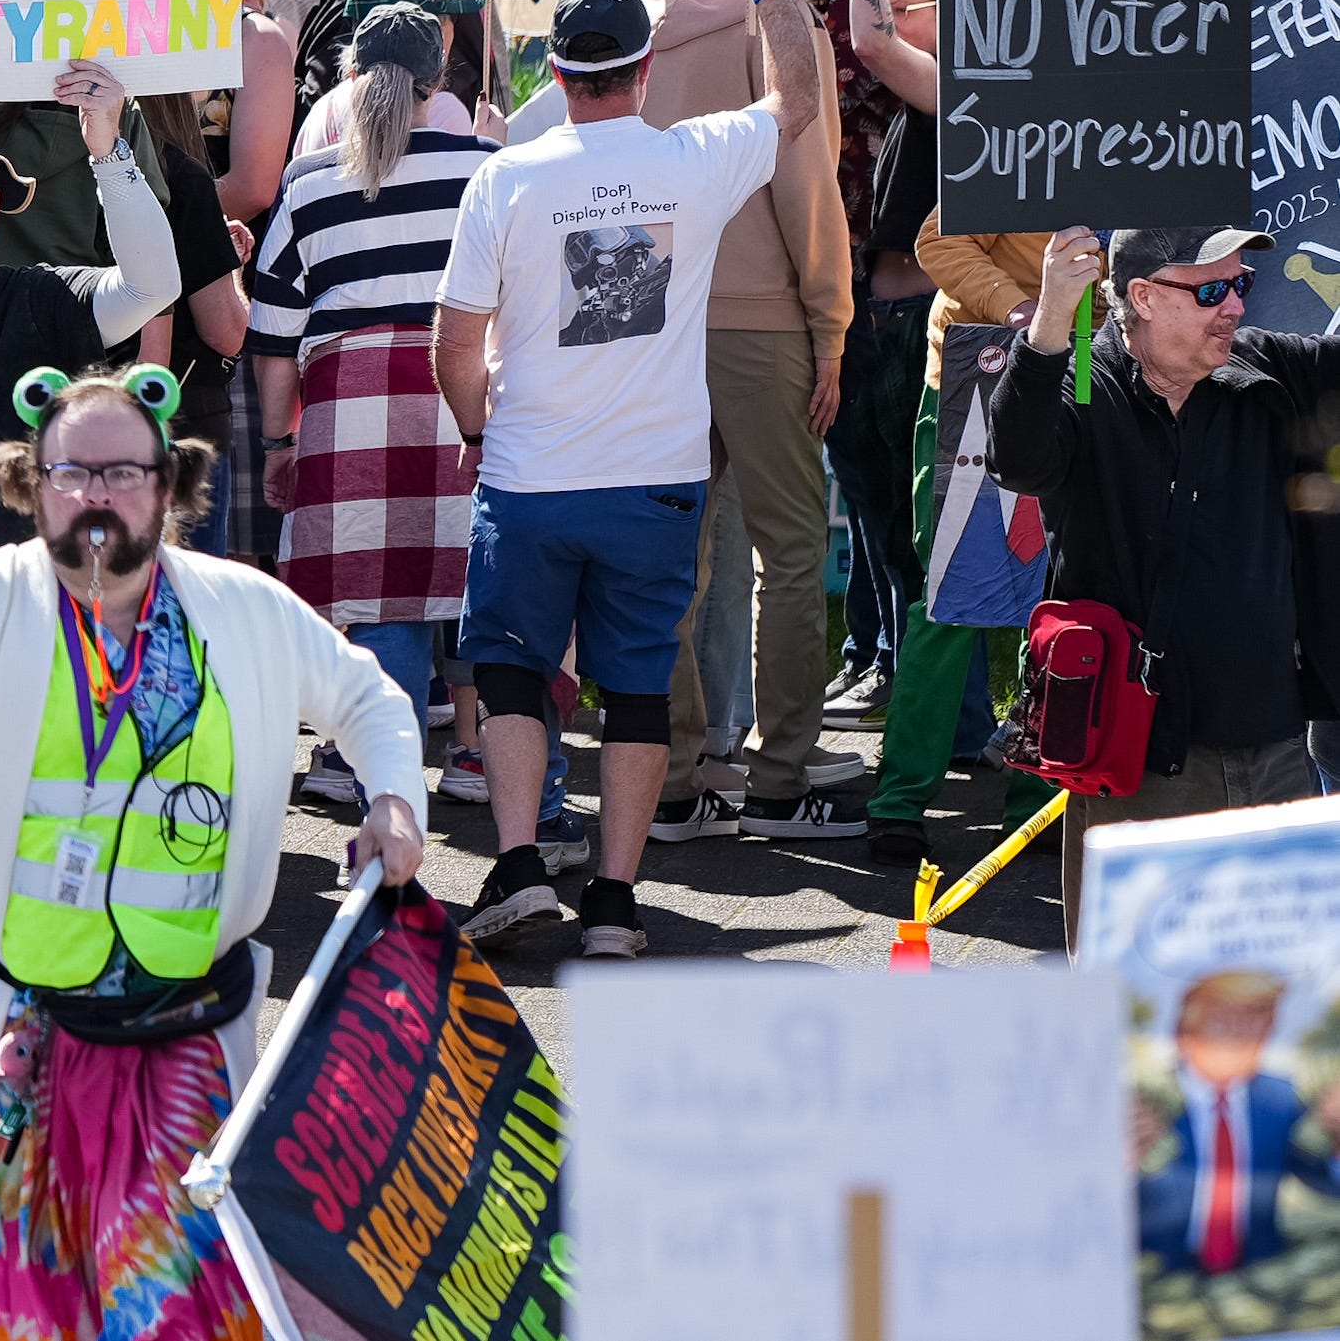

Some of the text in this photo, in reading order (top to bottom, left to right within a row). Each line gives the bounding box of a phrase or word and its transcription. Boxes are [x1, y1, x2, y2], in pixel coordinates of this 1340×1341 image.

[591, 184, 632, 202] [DoP]
[944, 92, 1246, 201] Suppression
[553, 199, 678, 225] Display of Power
[274, 1009, 416, 1234] SCIENCE
[345, 1157, 448, 1310] BLACK
[406, 1071, 481, 1208] LIVES
